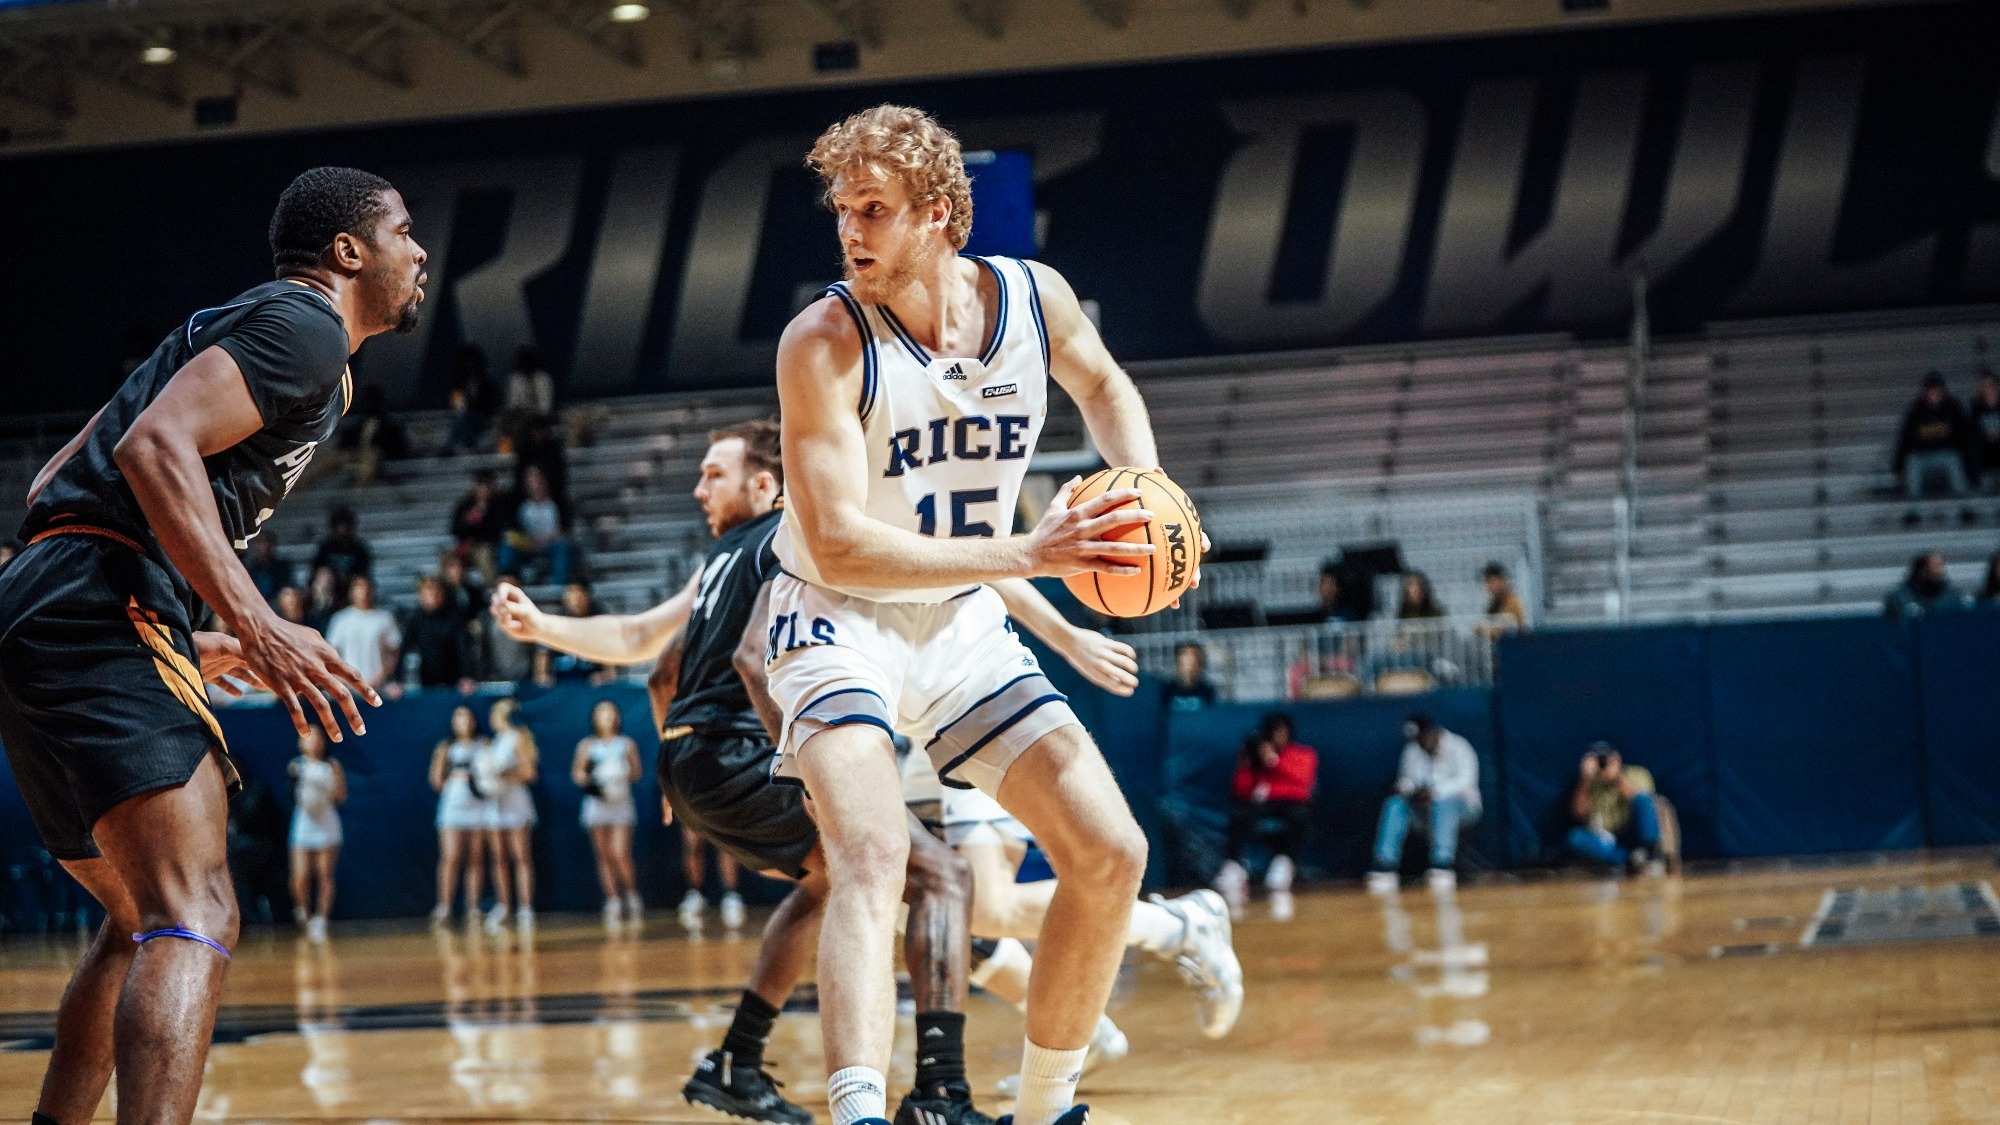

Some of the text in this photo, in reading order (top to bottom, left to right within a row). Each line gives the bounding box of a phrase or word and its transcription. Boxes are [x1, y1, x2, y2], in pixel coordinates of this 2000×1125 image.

[357, 106, 1104, 402] RIC
[943, 373, 967, 381] adidas
[883, 414, 1030, 478] RICE
[915, 486, 999, 538] 15
[1165, 523, 1187, 591] NCAA
